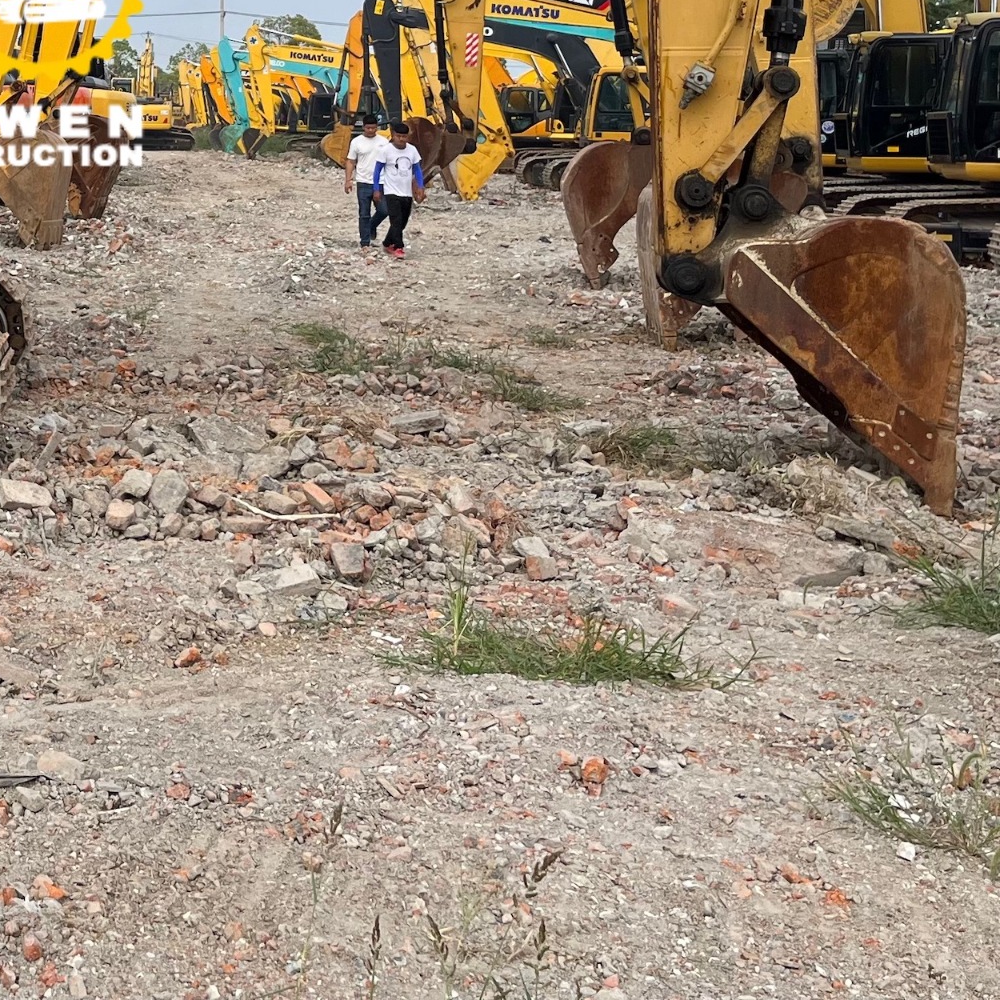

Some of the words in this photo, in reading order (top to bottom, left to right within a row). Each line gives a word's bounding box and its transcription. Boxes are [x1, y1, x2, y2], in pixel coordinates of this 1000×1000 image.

[491, 3, 560, 19] KOMATSU
[290, 51, 334, 64] KOMATSU
[906, 125, 928, 139] REG
